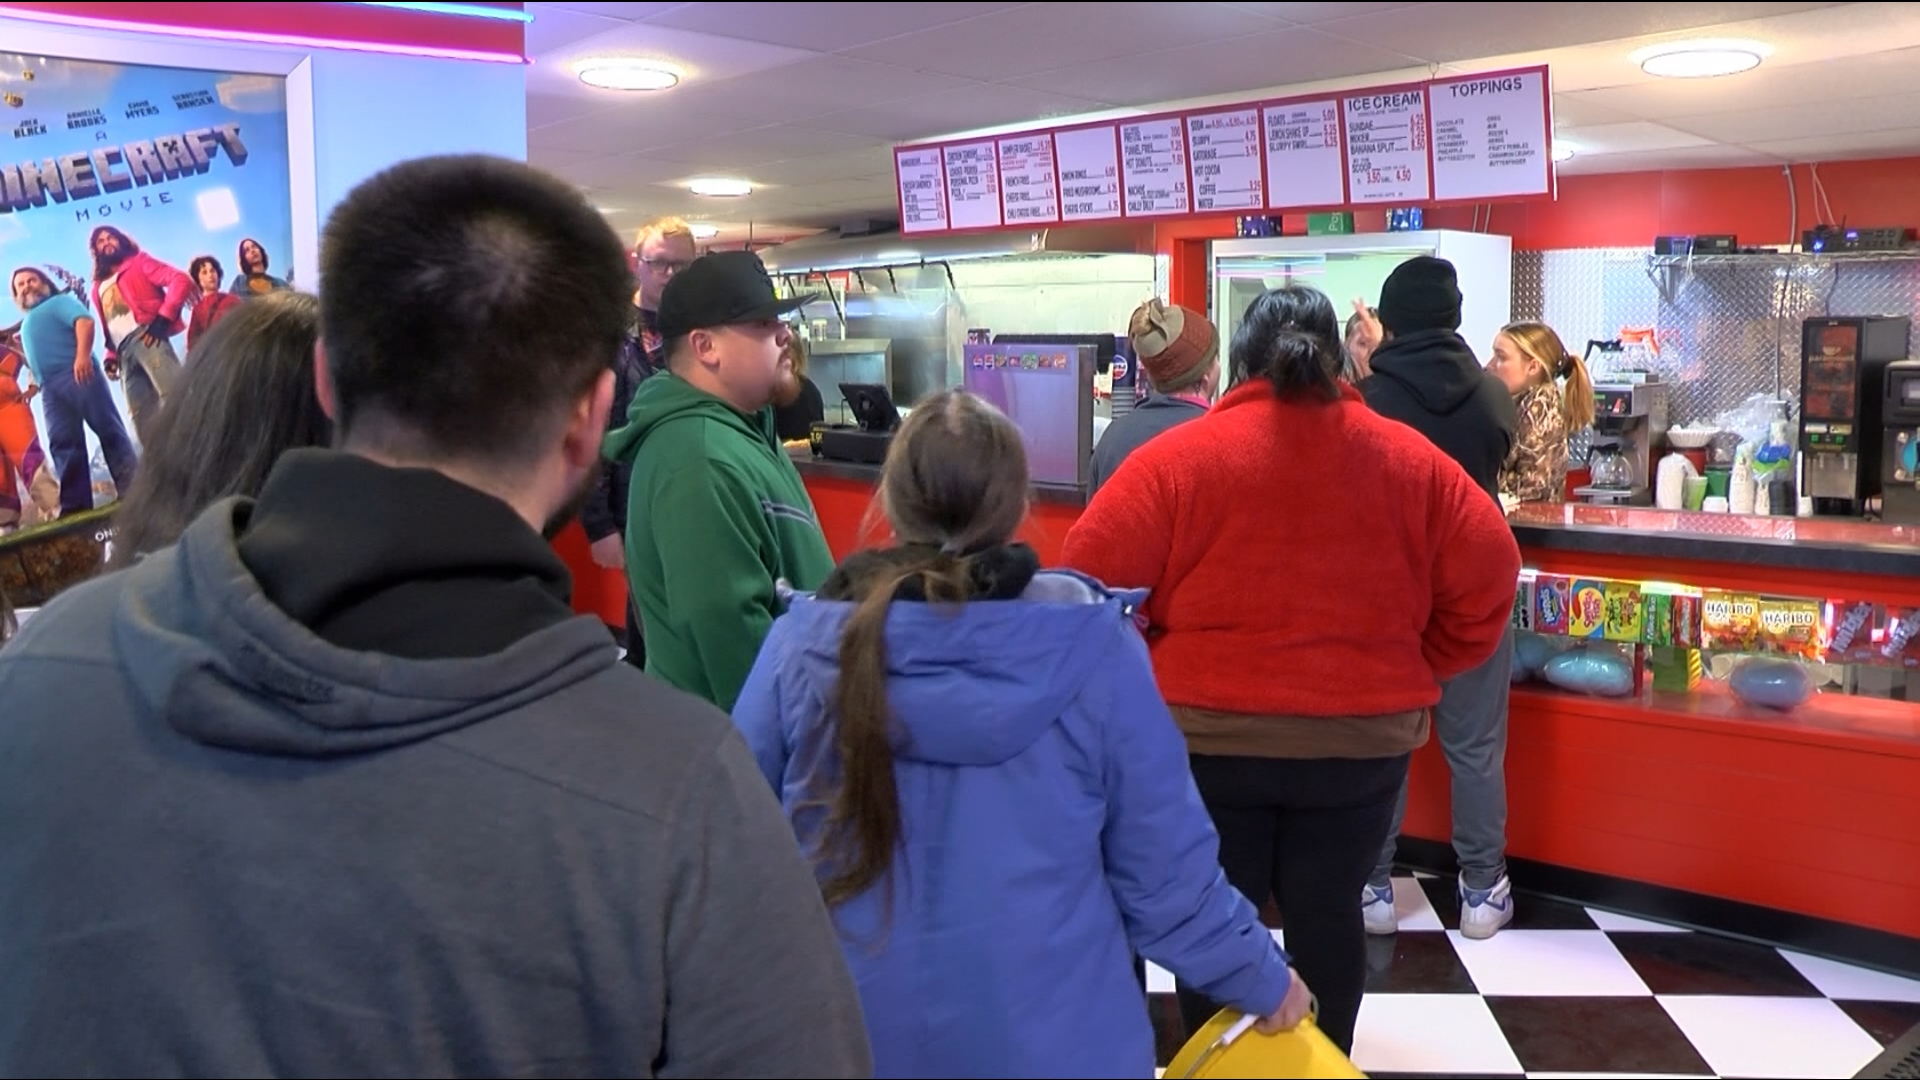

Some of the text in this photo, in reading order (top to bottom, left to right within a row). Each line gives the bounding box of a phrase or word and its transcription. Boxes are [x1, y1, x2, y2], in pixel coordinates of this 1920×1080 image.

[1449, 77, 1522, 97] TOPPINGS
[1349, 92, 1421, 112] ICE CREAM
[125, 106, 160, 119] MYERS
[1267, 113, 1286, 127] FLOATS
[1322, 108, 1335, 121] 5.00
[19, 118, 38, 127] JACK
[67, 114, 107, 129] BROOKS
[1191, 120, 1204, 132] SODA
[1349, 120, 1373, 133] SUNDAE
[1436, 118, 1464, 127] CHOCOLATE
[14, 124, 47, 139] BLACK
[95, 130, 107, 141] A
[1269, 128, 1286, 141] LEMON
[1286, 126, 1301, 139] SHAKE
[1302, 126, 1309, 137] UP
[1350, 132, 1370, 143] MIXER
[1192, 130, 1256, 147] SLURPY 4.75
[1269, 141, 1292, 153] SLURPY
[1292, 140, 1307, 151] SWIRL
[1350, 143, 1376, 155] BANANA
[1377, 142, 1395, 153] SPLIT
[1438, 147, 1463, 155] PINEAPPLE
[1506, 142, 1529, 150] PEBBLES
[1193, 148, 1217, 161] GATORADE
[1438, 154, 1476, 162] BUTTERSCOTCH
[1126, 158, 1134, 169] HOT
[1135, 156, 1152, 168] DONUTS
[1352, 162, 1372, 173] SCOOP
[1489, 158, 1526, 167] BUTTERFINGER
[1195, 164, 1220, 176] HOT COCOA
[1366, 170, 1381, 184] 3.50
[1396, 168, 1411, 182] 4.50
[1128, 184, 1145, 196] NACHOS
[1198, 183, 1216, 195] COFFEE
[76, 191, 174, 223] MOVIE
[1198, 197, 1214, 209] WATER
[1705, 601, 1754, 617] HARIBO
[1764, 612, 1814, 626] HARIBO
